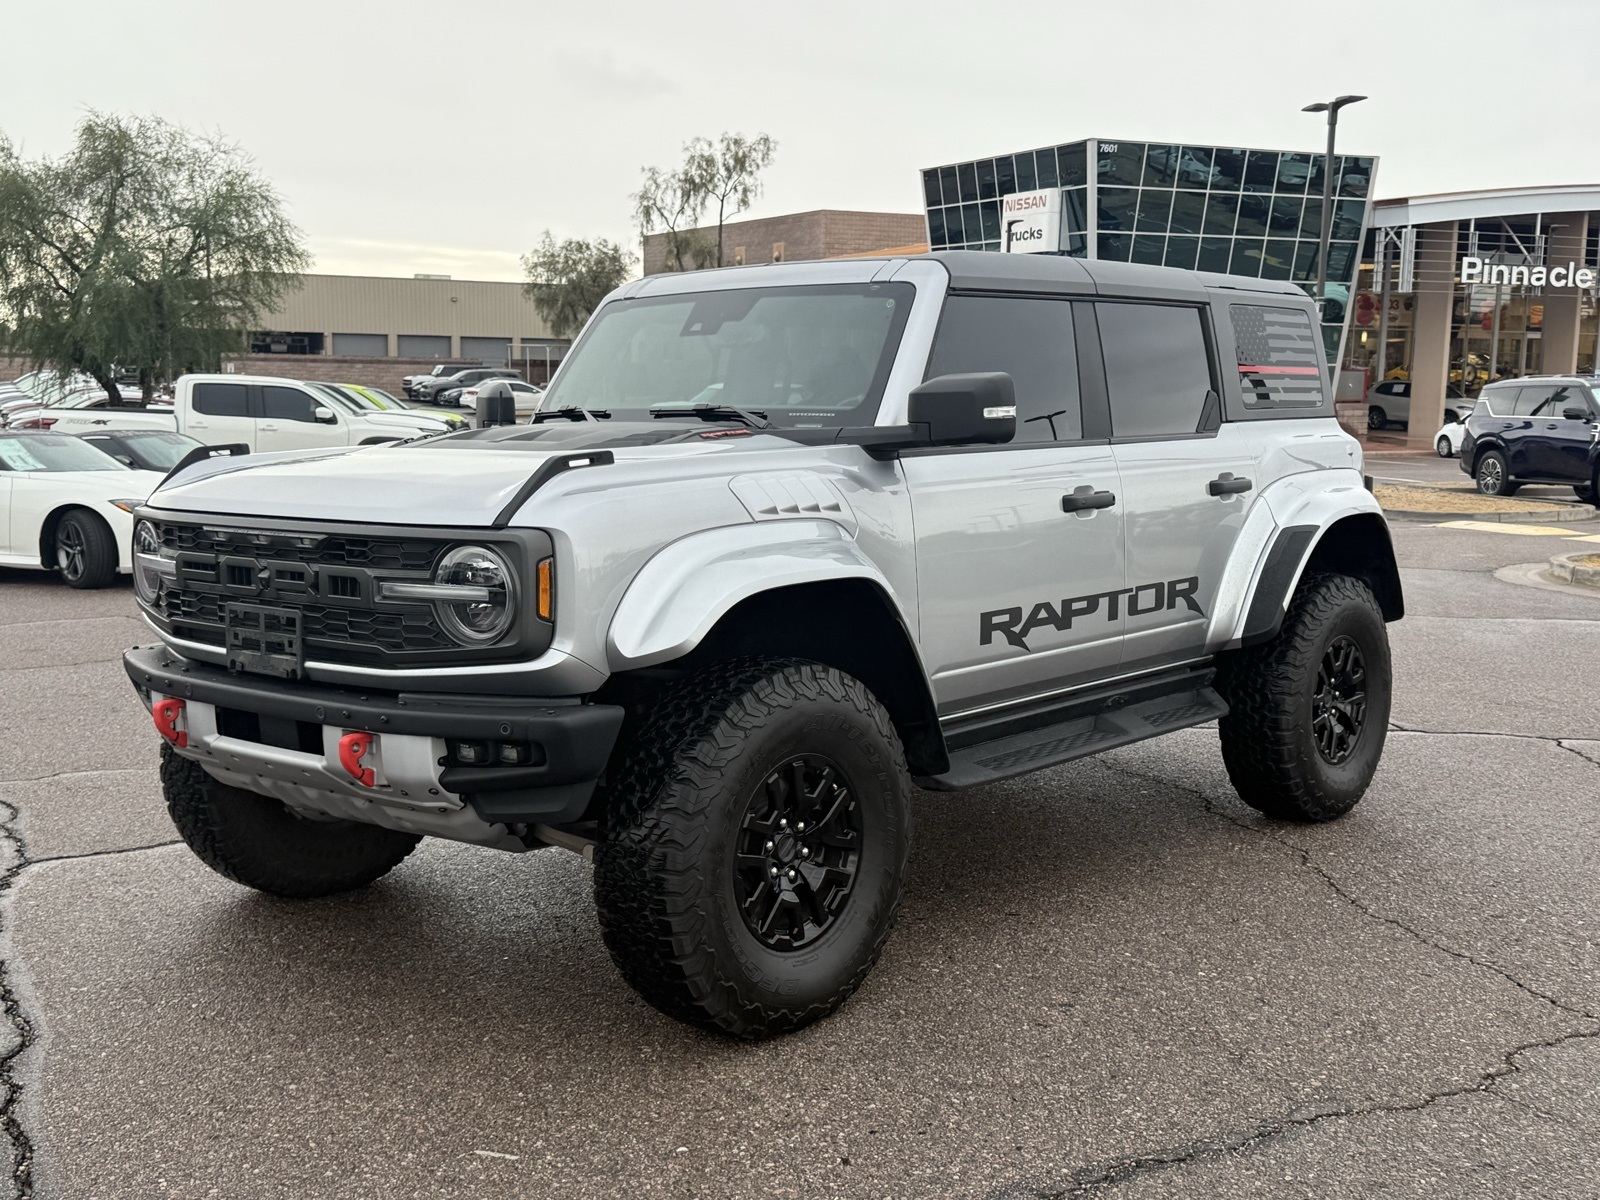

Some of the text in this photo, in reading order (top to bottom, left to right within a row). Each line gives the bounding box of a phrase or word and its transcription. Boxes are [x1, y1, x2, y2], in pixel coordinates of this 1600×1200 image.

[1099, 143, 1118, 153] 7601
[1005, 195, 1047, 213] NISSAN
[1005, 227, 1043, 242] rucks
[1461, 256, 1594, 289] Pinnacle
[175, 552, 372, 607] FORD
[979, 575, 1205, 653] RAPTOR
